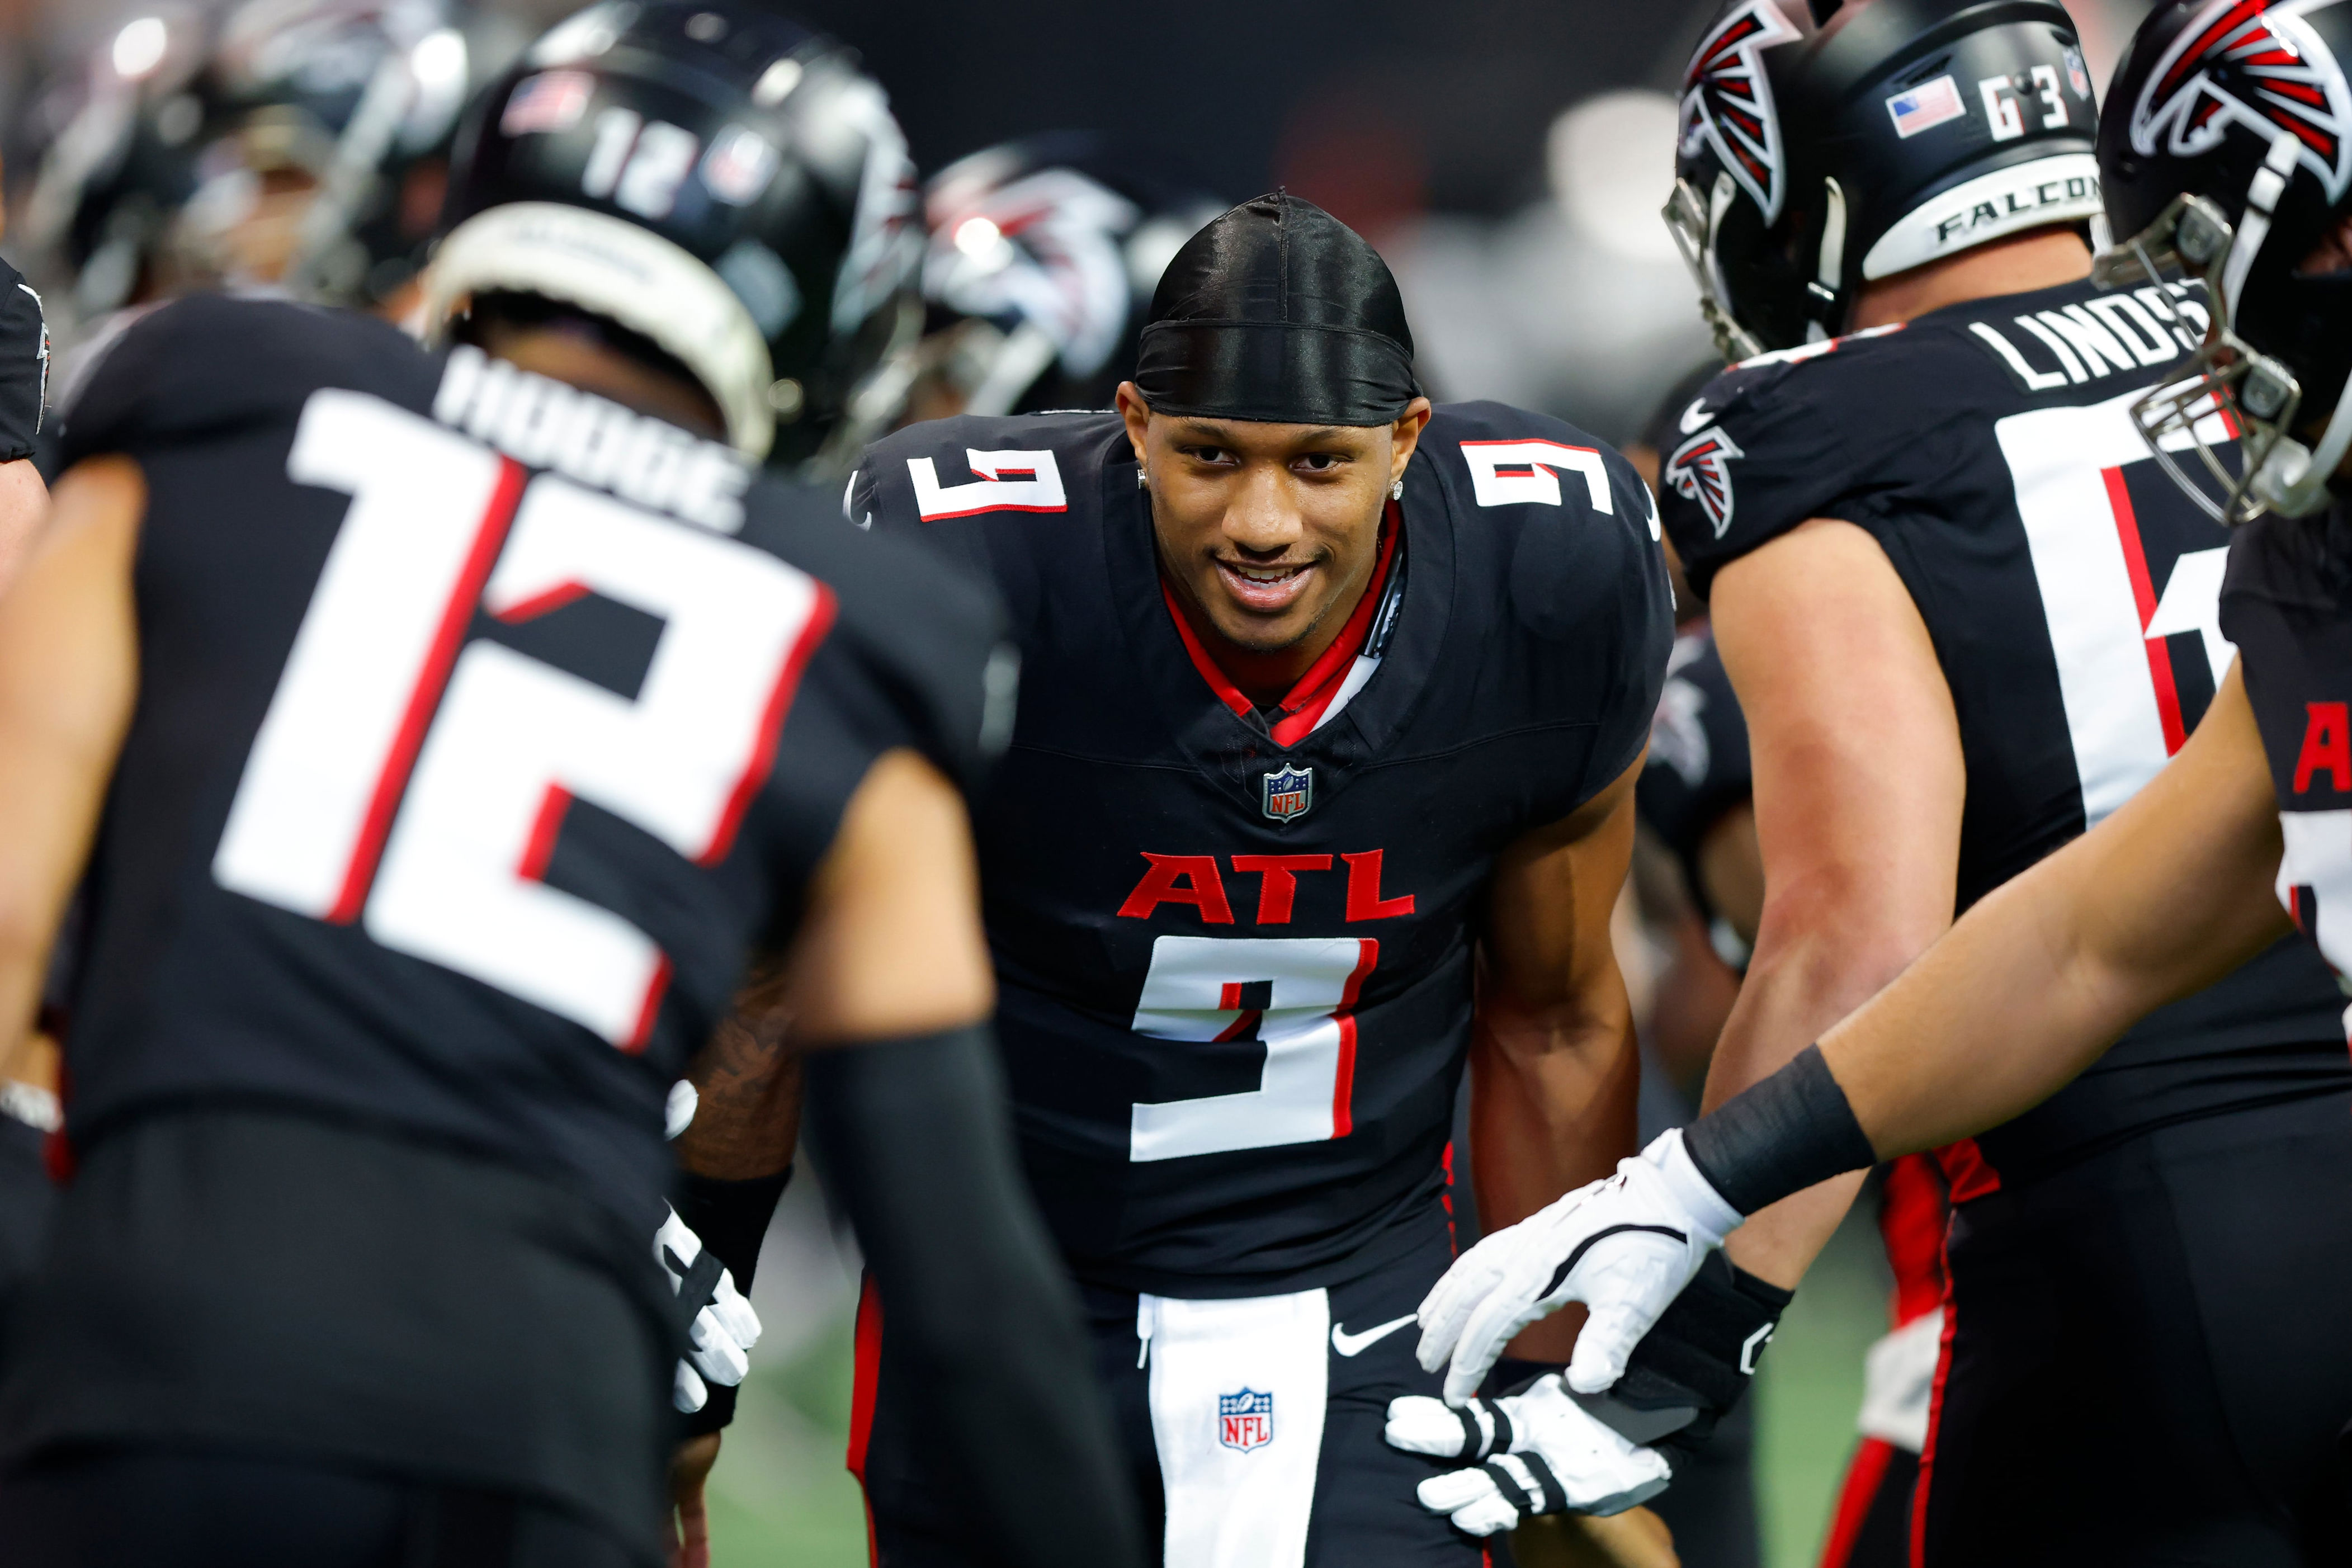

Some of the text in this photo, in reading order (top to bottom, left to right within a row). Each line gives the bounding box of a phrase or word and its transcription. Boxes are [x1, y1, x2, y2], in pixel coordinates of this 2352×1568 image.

[1978, 64, 2070, 142] 63
[582, 106, 699, 220] 12
[1968, 278, 2210, 391] LINDS
[1460, 439, 1613, 515] 9
[211, 388, 839, 1054] 12
[1271, 792, 1304, 814] NFL
[1117, 849, 1415, 924] ATL
[1130, 936, 1380, 1162] 9
[1223, 1415, 1268, 1446] NFL
